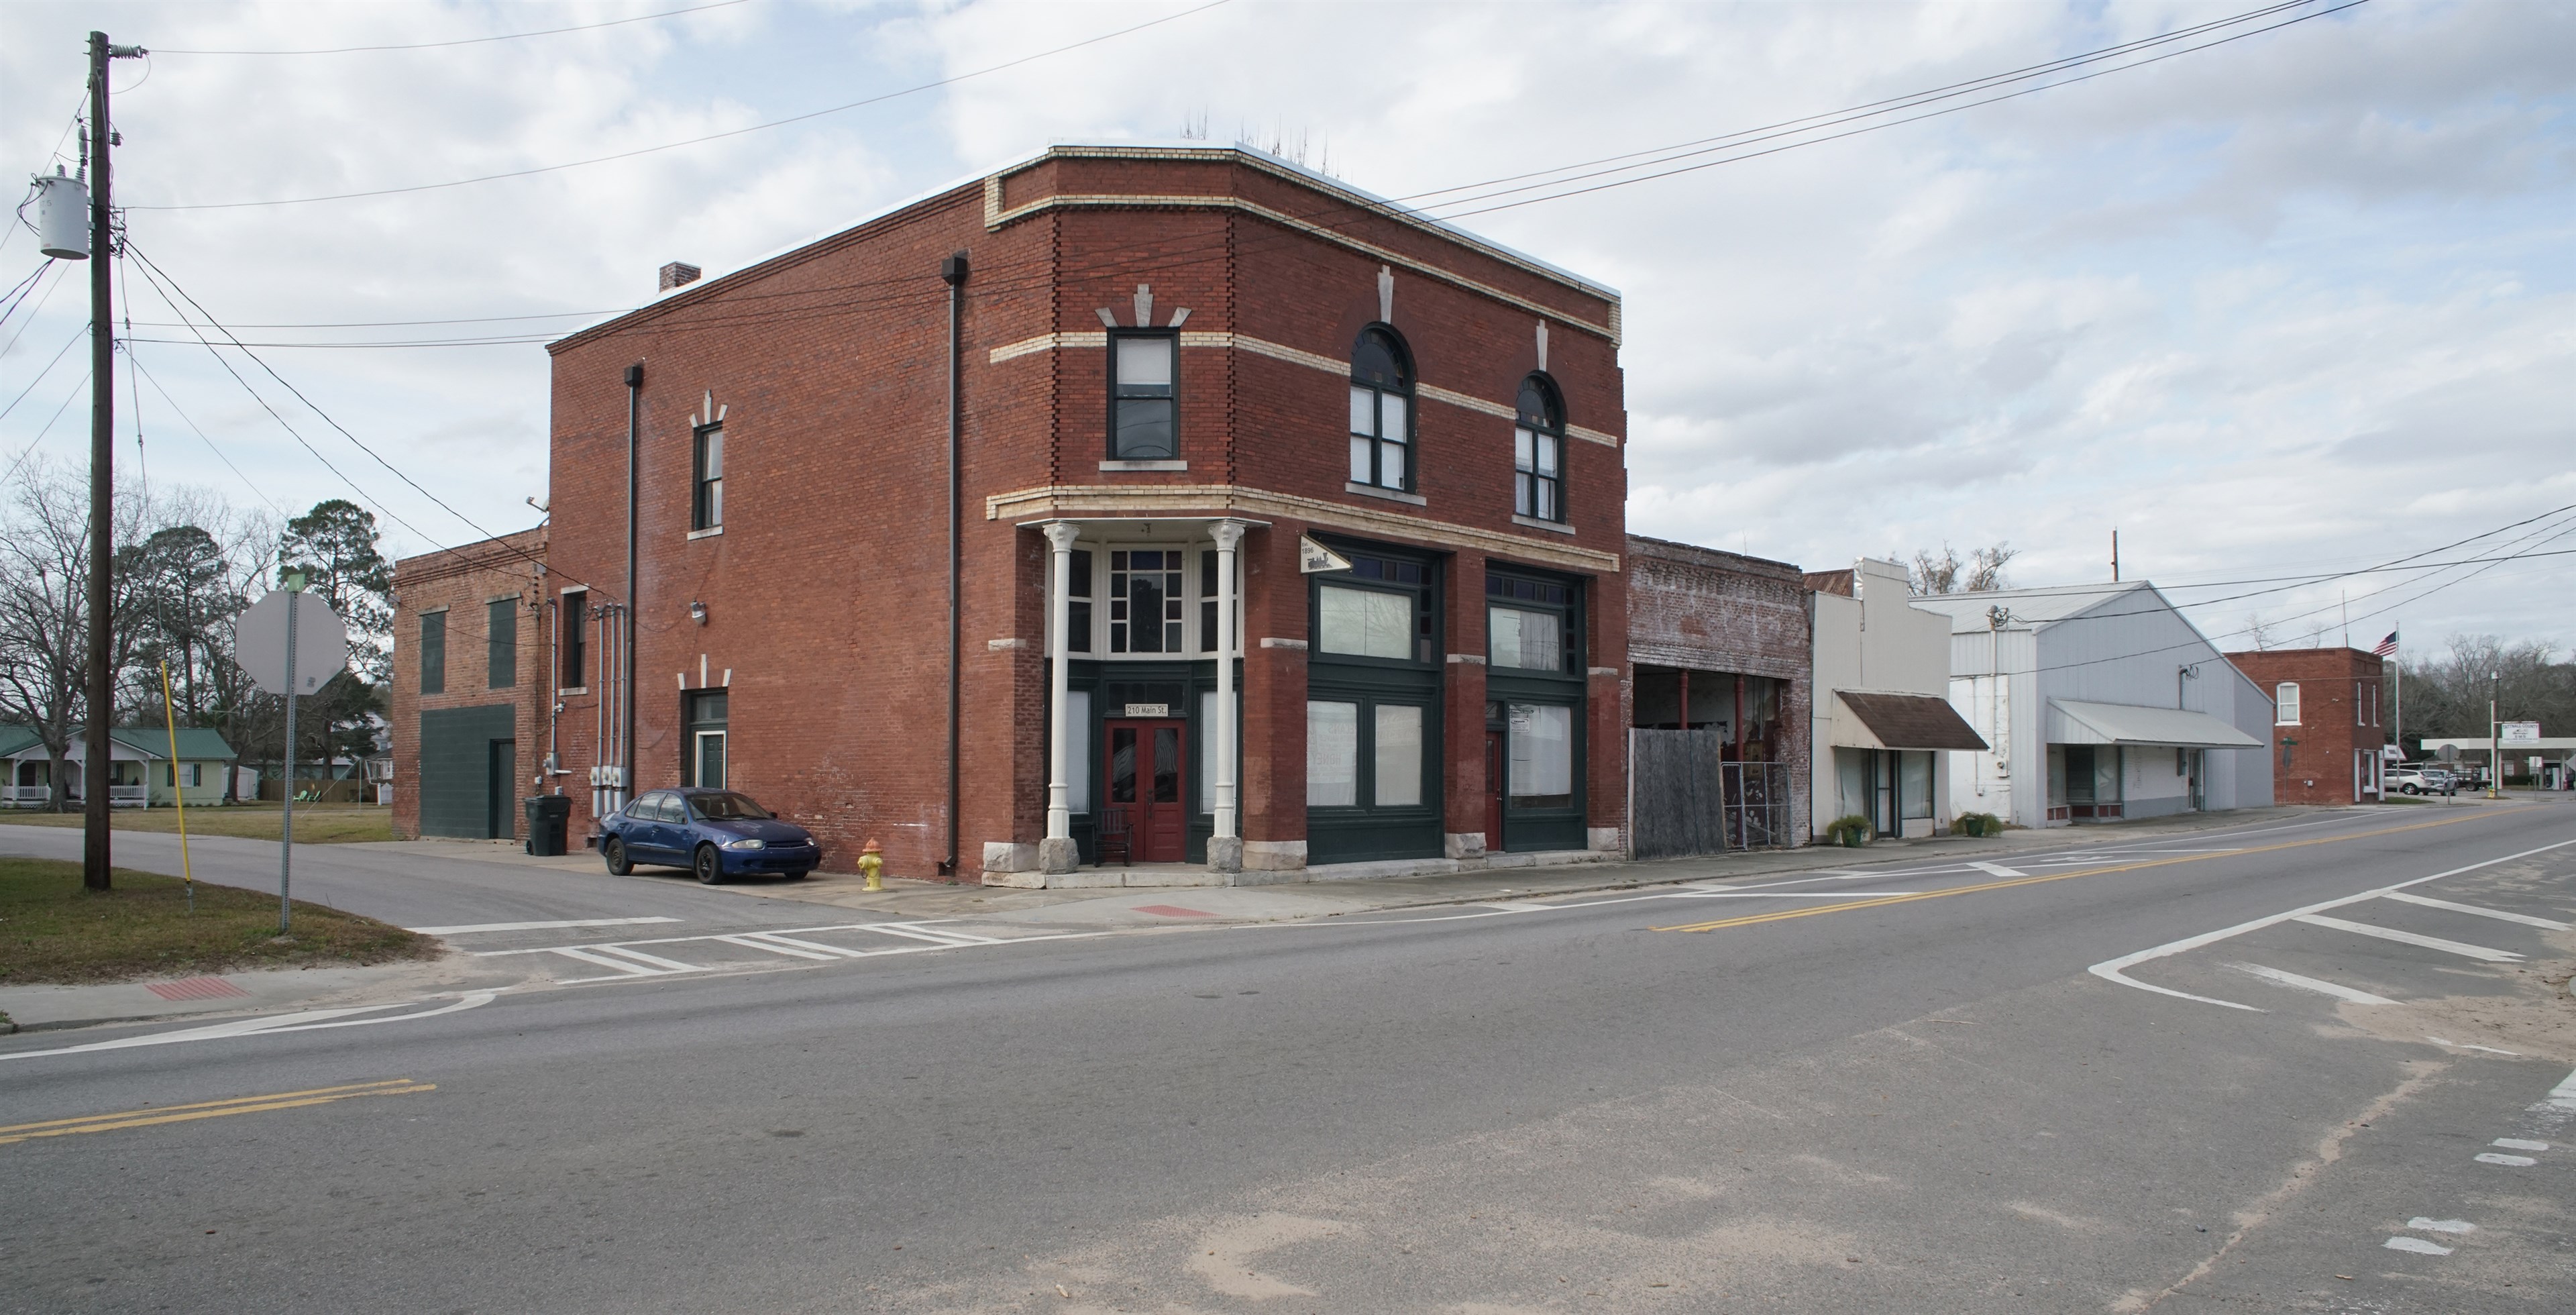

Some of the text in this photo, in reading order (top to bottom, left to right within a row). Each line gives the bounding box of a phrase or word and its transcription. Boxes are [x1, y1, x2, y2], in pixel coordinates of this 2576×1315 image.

[1301, 547, 1314, 555] 1896
[1128, 706, 1140, 714] 210
[1158, 706, 1167, 714] St.
